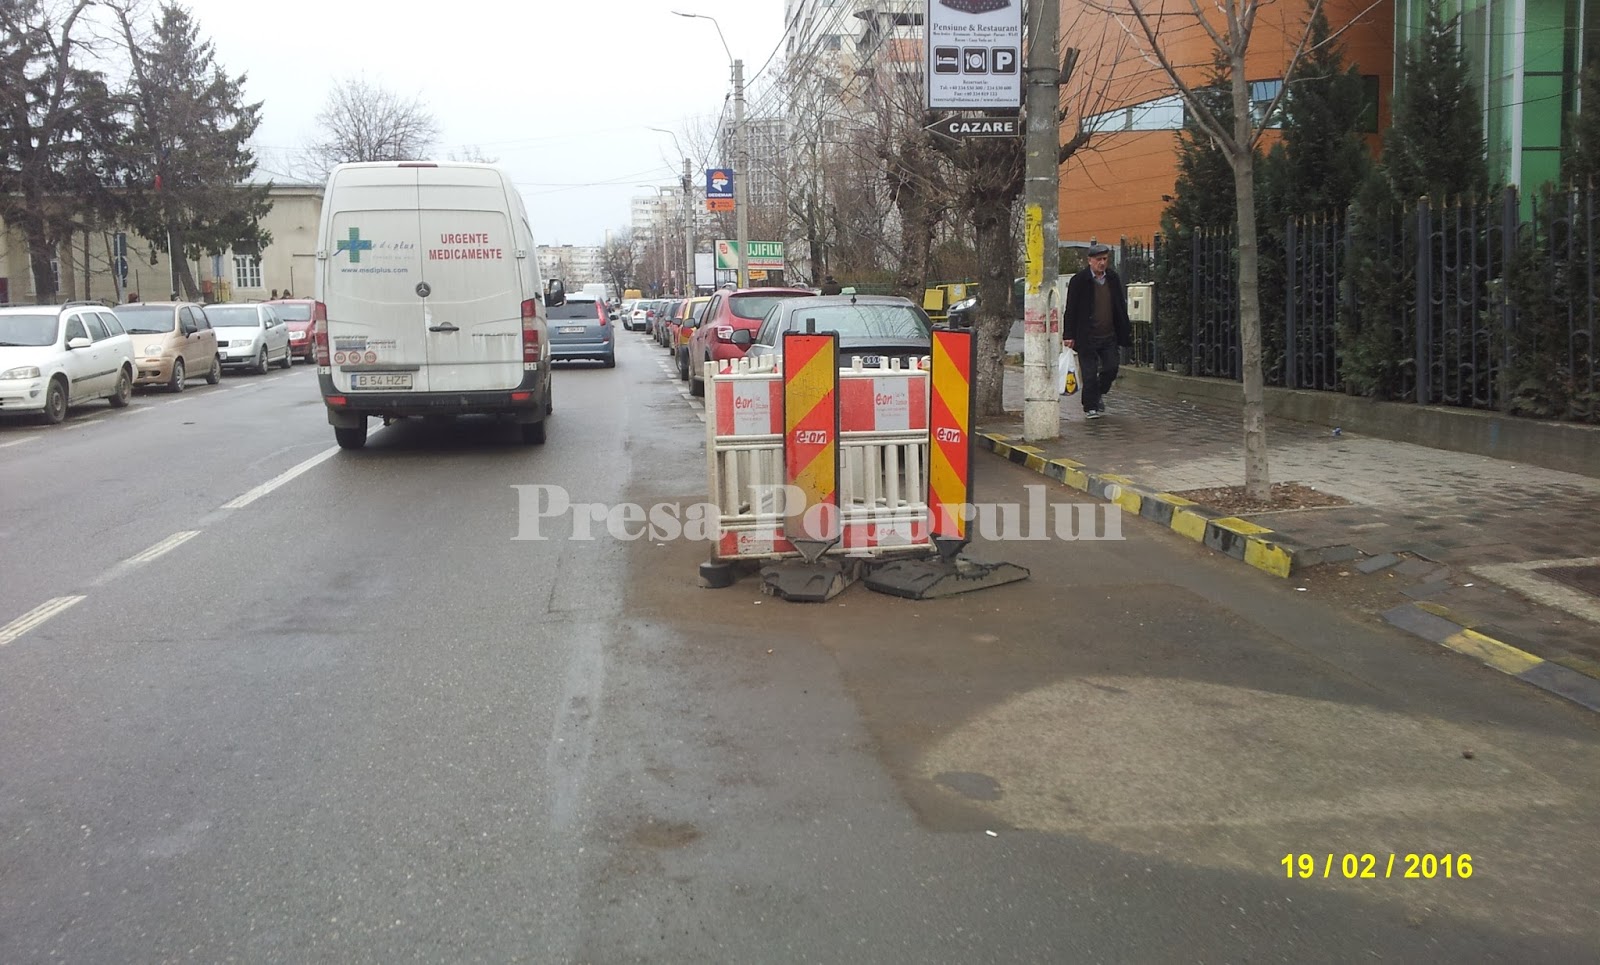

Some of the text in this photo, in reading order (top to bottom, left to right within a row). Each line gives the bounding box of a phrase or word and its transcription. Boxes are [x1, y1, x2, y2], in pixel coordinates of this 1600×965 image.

[933, 23, 967, 32] Pensiune
[977, 24, 1018, 32] Restaurant
[949, 122, 1013, 133] CAZARE
[429, 249, 502, 260] MEDICAMENTE
[747, 243, 782, 256] UJIFILM
[359, 375, 409, 386] B 54 HZF
